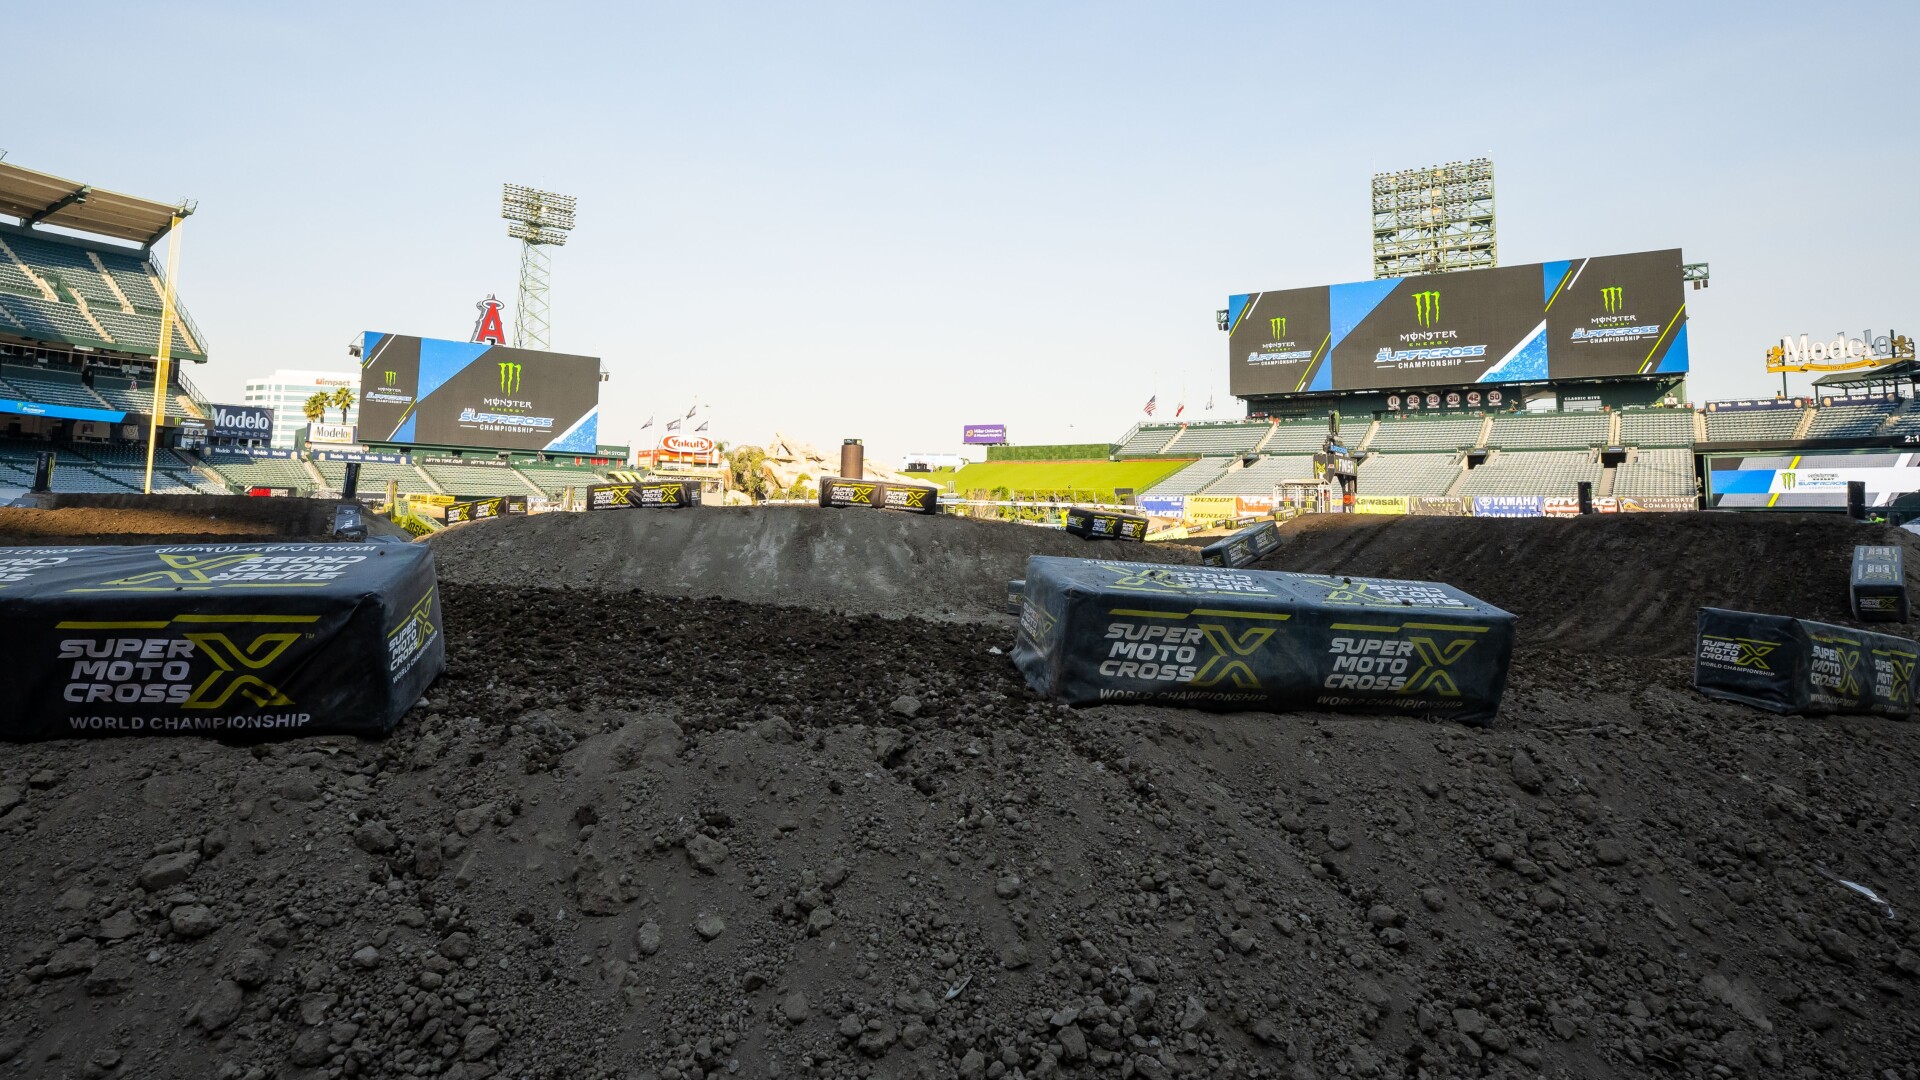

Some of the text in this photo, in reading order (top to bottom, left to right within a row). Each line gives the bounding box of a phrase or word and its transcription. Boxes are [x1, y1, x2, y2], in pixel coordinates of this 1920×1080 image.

[1591, 315, 1636, 324] MONSTER
[1400, 330, 1458, 342] MONSTER
[1570, 325, 1660, 340] SUPERCROSS
[1590, 336, 1640, 344] CHAMPIONSHIP
[1374, 345, 1487, 362] SUPERCROSS
[1783, 329, 1892, 363] Modelo
[1398, 359, 1461, 369] CHAMPIONSHIP
[323, 378, 351, 387] impact
[483, 397, 532, 409] MONSTER
[211, 408, 270, 431] Modelo
[458, 411, 554, 427] SUPERCROSS
[315, 426, 348, 439] Modelo
[479, 424, 534, 433] CHAMPIONSHIP
[672, 439, 706, 449] Yakult
[1355, 497, 1403, 506] Kawasaki
[1493, 497, 1538, 506] YAMAHA
[229, 564, 349, 572] MOTO
[241, 556, 367, 564] CROSS
[210, 572, 346, 581] SUPER
[1022, 611, 1038, 628] MOTO
[1023, 602, 1040, 621] SUPER
[389, 617, 417, 652] SUPER
[1020, 618, 1037, 638] CROSS
[1104, 623, 1204, 644] SUPER
[57, 638, 196, 659] SUPER
[392, 628, 417, 660] MOTO
[1328, 637, 1415, 657] SUPER
[1701, 639, 1742, 651] SUPER
[1703, 645, 1740, 657] MOTO
[390, 638, 418, 671] CROSS
[392, 630, 438, 684] WORLD CHAMPIONSHIP
[1108, 642, 1196, 663] MOTO
[1700, 652, 1739, 663] CROSS
[1811, 645, 1840, 662] SUPER
[70, 660, 190, 681] MOTO
[1099, 660, 1198, 682] CROSS
[1333, 655, 1408, 674] MOTO
[1700, 661, 1776, 677] WORLD CHAMPIONSHIP
[1812, 659, 1841, 676] MOTO
[1324, 674, 1408, 691] CROSS
[1810, 672, 1841, 689] CROSS
[63, 683, 192, 703] CROSS
[1100, 689, 1268, 702] WORLD CHAMPIONSHIP
[69, 713, 311, 729] WORLD CHAMPIONSHIP
